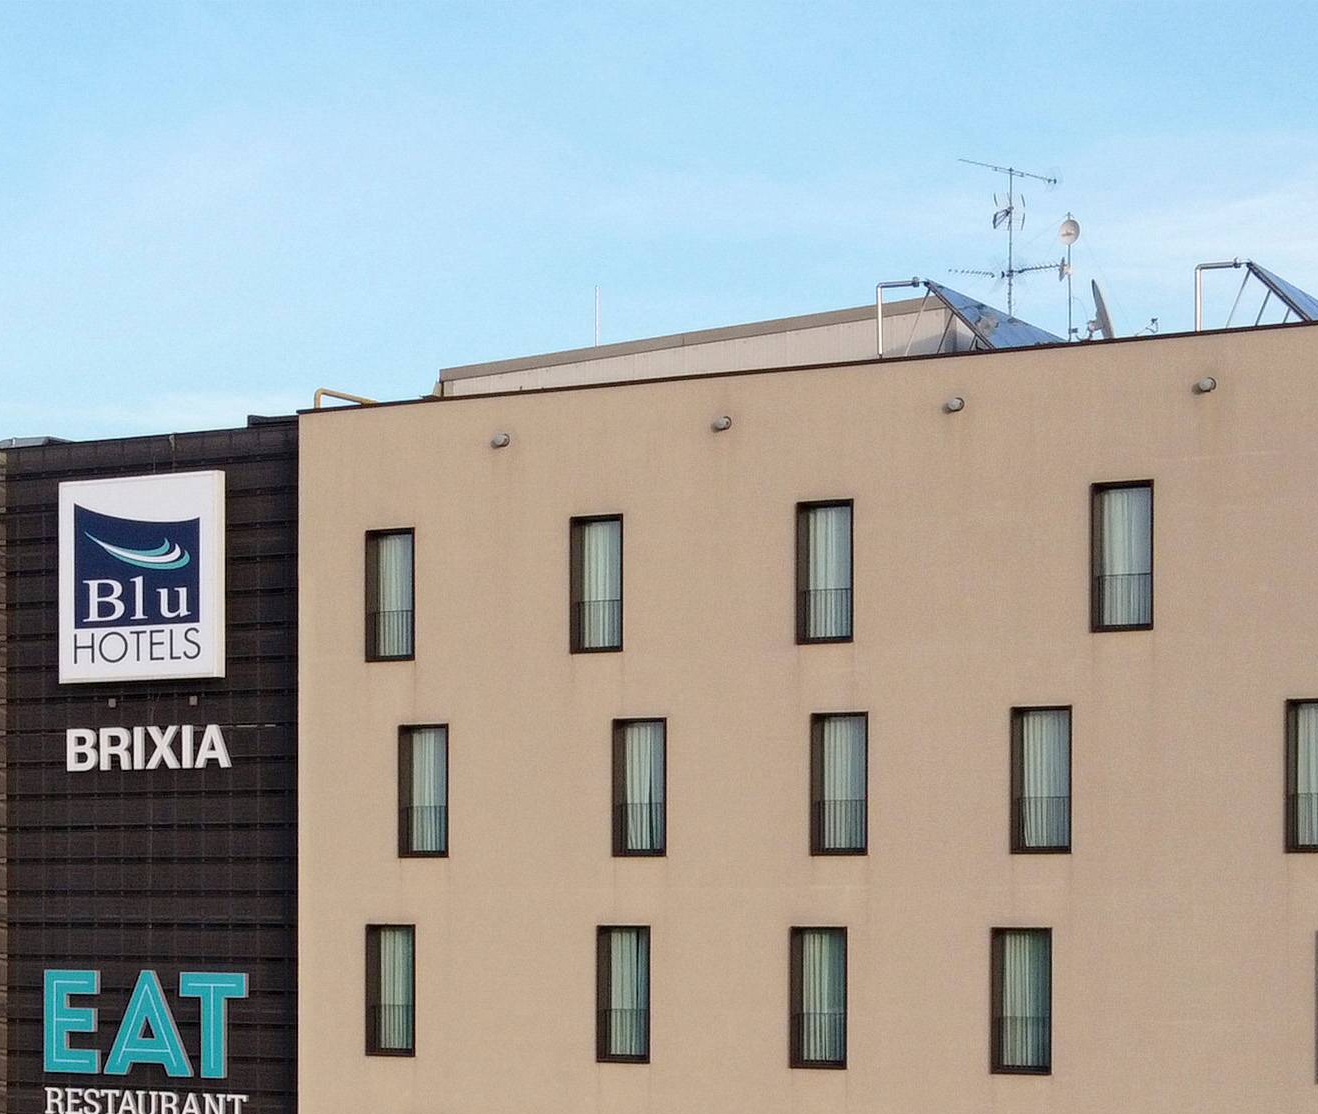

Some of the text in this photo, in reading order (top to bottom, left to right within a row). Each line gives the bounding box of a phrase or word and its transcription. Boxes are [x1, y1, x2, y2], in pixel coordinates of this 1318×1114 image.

[83, 575, 191, 622] Blu
[74, 627, 201, 664] HOTELS
[66, 724, 232, 772] BRIXIA
[44, 969, 249, 1079] EAT
